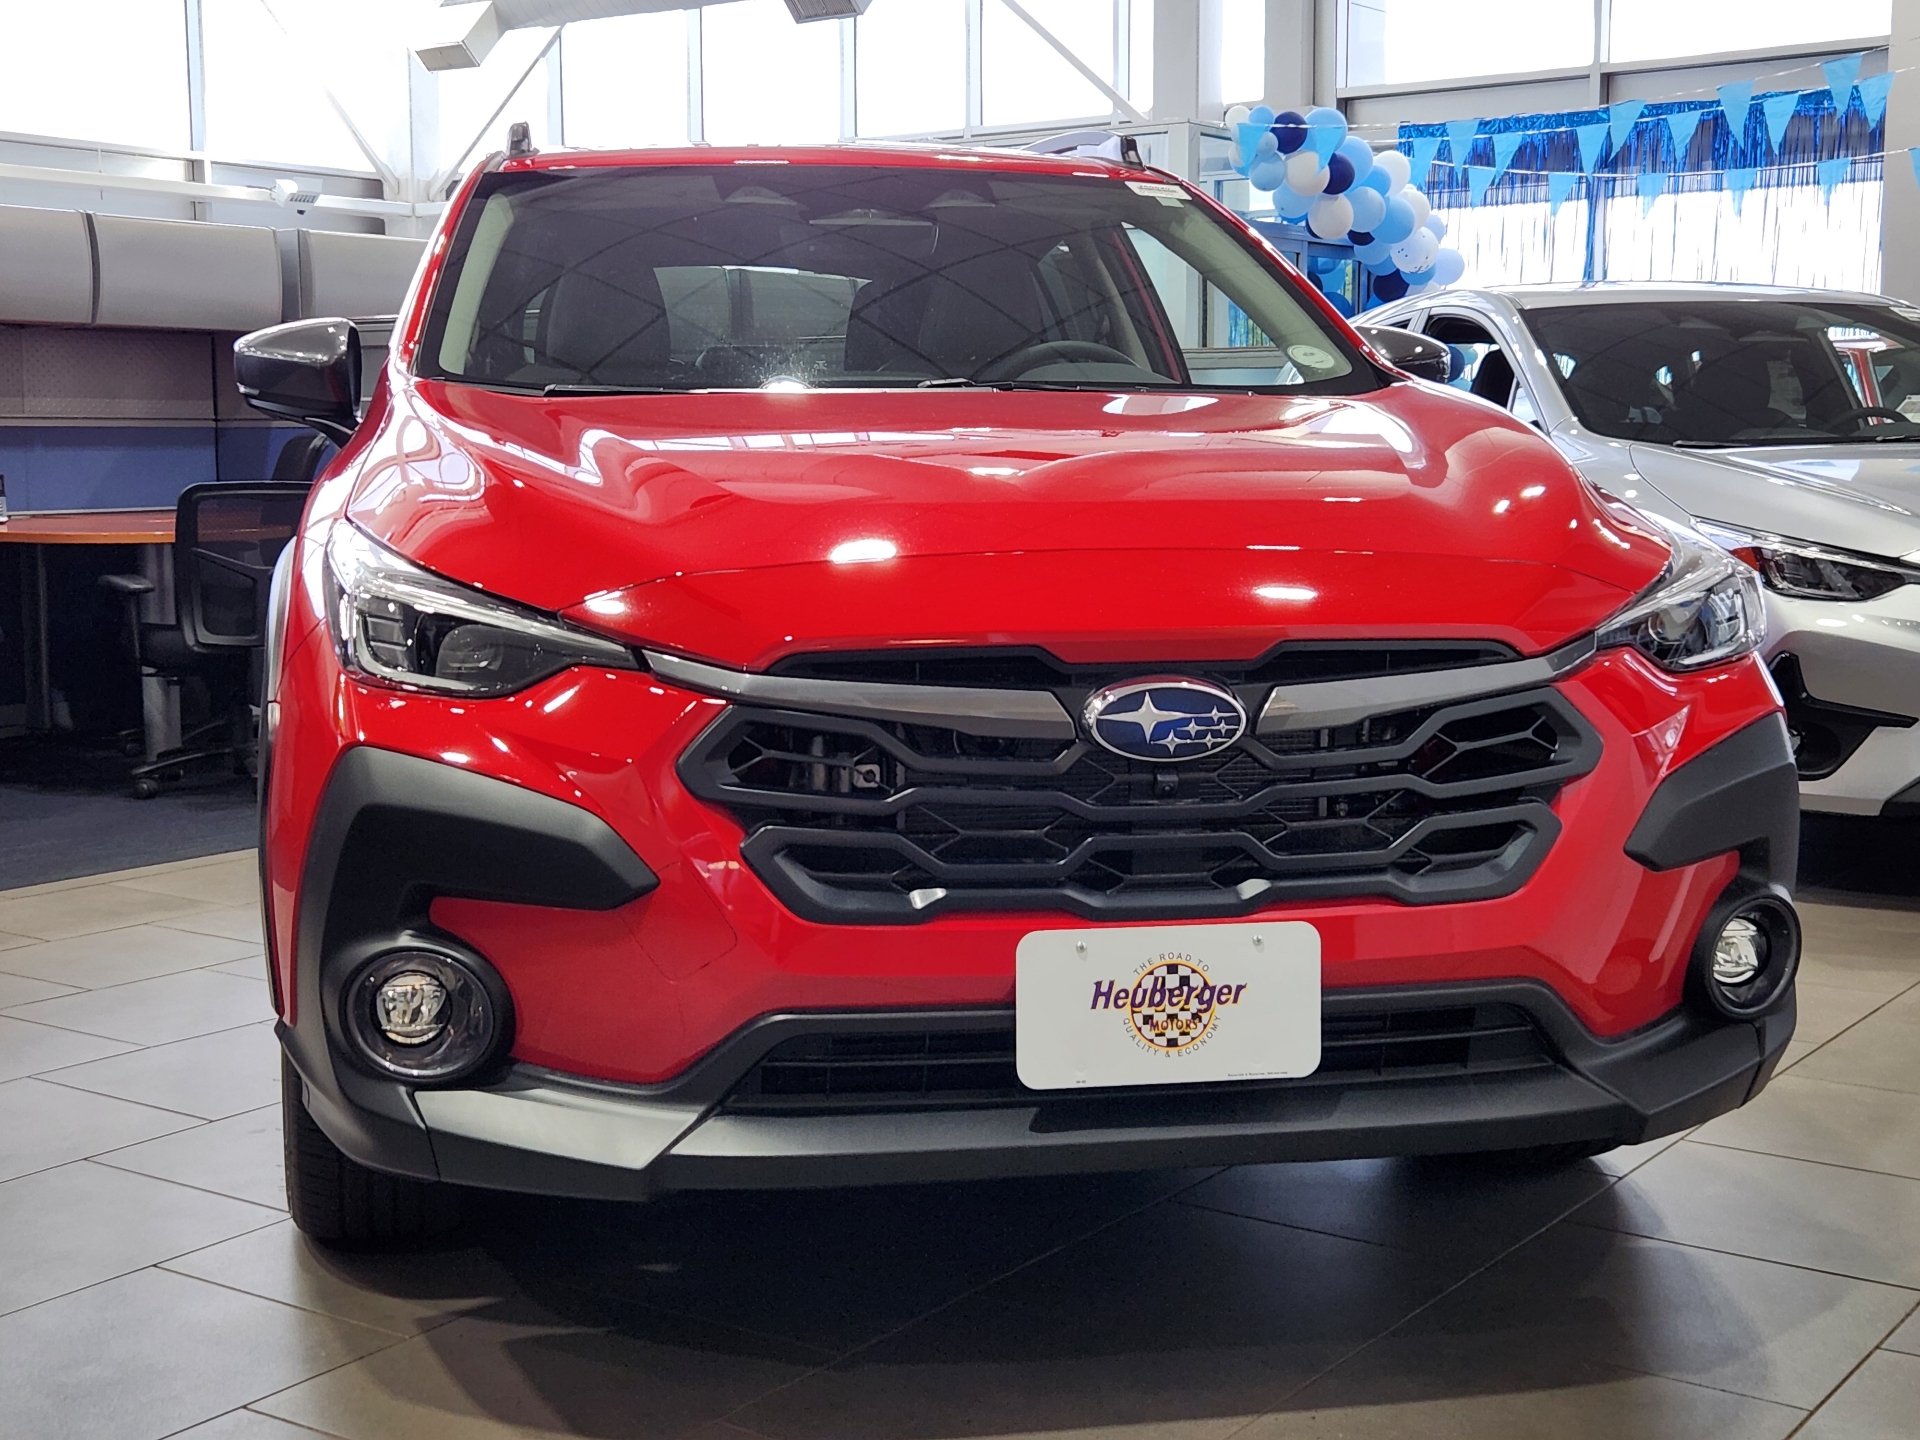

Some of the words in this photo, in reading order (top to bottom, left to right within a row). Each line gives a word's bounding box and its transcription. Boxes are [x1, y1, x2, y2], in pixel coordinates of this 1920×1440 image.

[1133, 958, 1154, 976] THE
[1159, 952, 1192, 961] ROAD
[1197, 959, 1210, 972] TO
[1090, 976, 1248, 1014] Heuberger
[1123, 1018, 1159, 1056] QUALITY
[1165, 1050, 1171, 1058] &
[1177, 1016, 1221, 1057] ECONOMY
[1149, 1018, 1198, 1032] MOTORS
